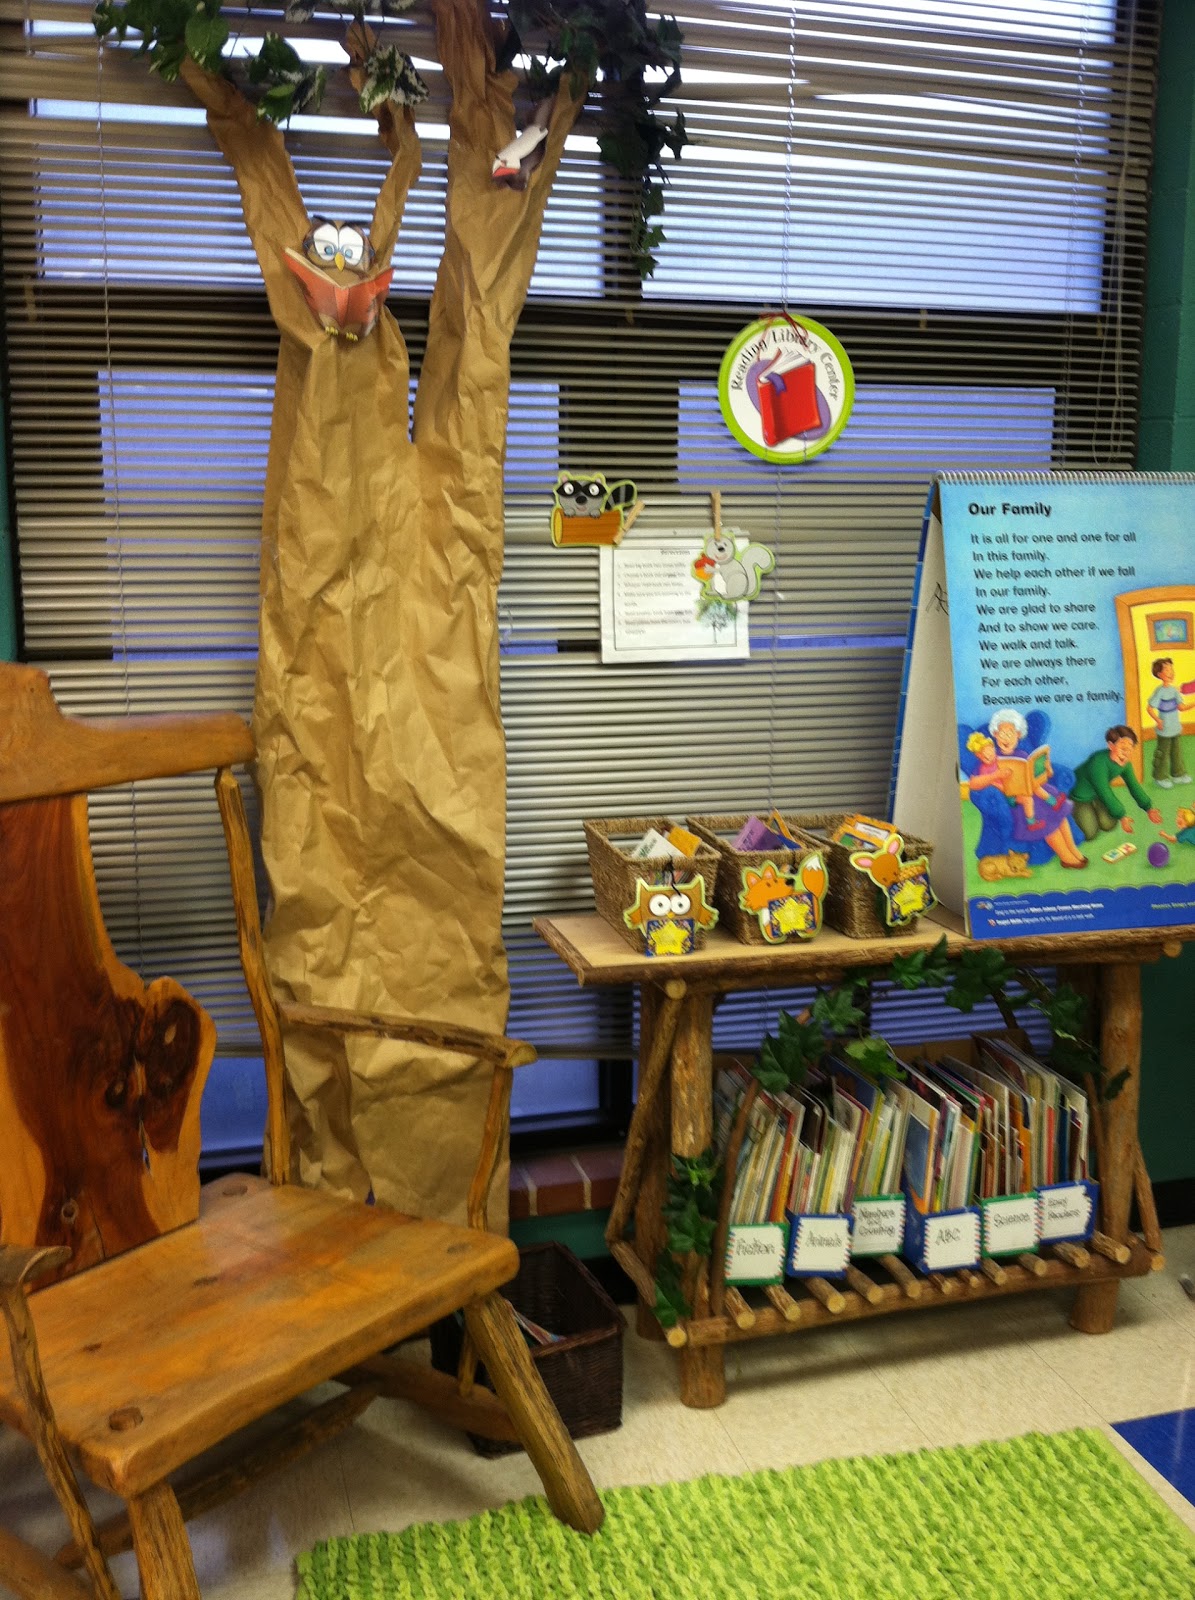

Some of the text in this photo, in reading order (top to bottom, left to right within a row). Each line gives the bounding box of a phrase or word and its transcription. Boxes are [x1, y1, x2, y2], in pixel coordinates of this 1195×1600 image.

[731, 338, 768, 391] Reading
[820, 352, 840, 401] Center
[968, 501, 1052, 517] Our Family
[971, 531, 1136, 544] It is all for one and one for all
[972, 549, 1050, 562] In this family.
[974, 566, 1136, 580] We help each other if we fall
[976, 585, 1051, 598] In our family.
[976, 602, 1096, 617] We are glad to share
[977, 622, 1001, 633] And
[1004, 622, 1016, 632] to
[1019, 621, 1049, 632] show
[1051, 622, 1068, 631] we
[978, 640, 998, 651] We
[1000, 639, 1027, 651] walk
[1030, 638, 1052, 650] and
[980, 656, 1096, 670] We are always there
[981, 676, 1001, 687] For
[1004, 675, 1032, 686] each
[982, 690, 1124, 706] Because we are a family.
